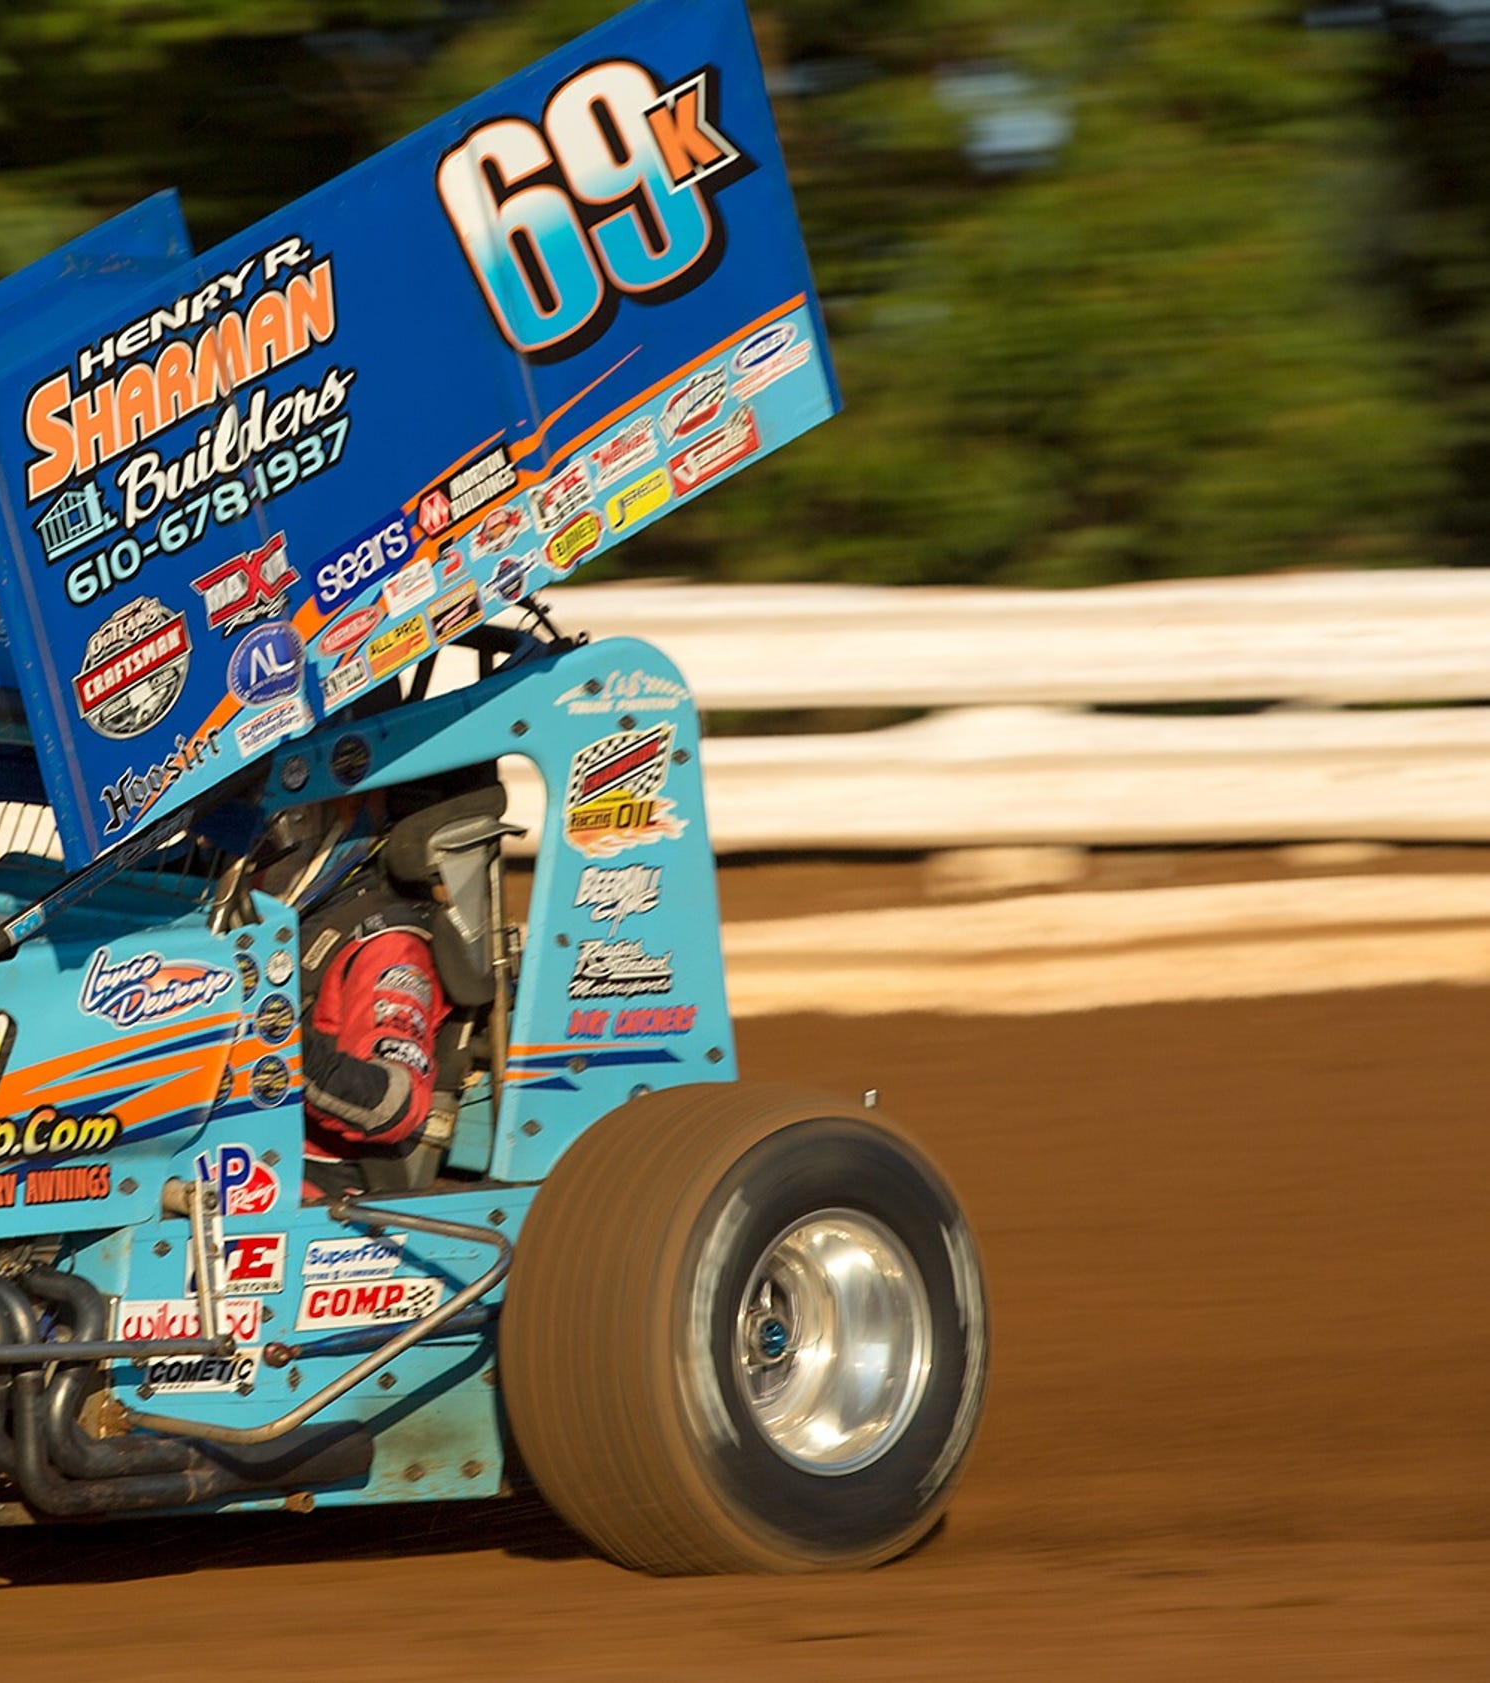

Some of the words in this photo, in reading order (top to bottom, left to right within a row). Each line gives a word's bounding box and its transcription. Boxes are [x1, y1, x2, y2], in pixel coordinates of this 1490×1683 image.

[436, 59, 713, 353] 69
[646, 86, 725, 184] K
[79, 259, 256, 380] HENRY
[264, 237, 311, 279] R.
[26, 258, 336, 502] SHARMAN
[118, 368, 356, 528] Builders
[66, 416, 350, 602] 610-678-1937
[316, 521, 408, 602] sears
[83, 625, 182, 703] CRAFTSMAN
[100, 733, 222, 836] Hoosier
[616, 800, 658, 829] OIL
[85, 948, 160, 1012] Lance
[102, 970, 233, 1028] Dewease
[24, 1165, 110, 1205] AWNINGS
[309, 1243, 399, 1267] SuperFlow
[123, 1301, 259, 1342] wilwd
[308, 1284, 404, 1319] COMP
[150, 1358, 254, 1383] COMETIC
